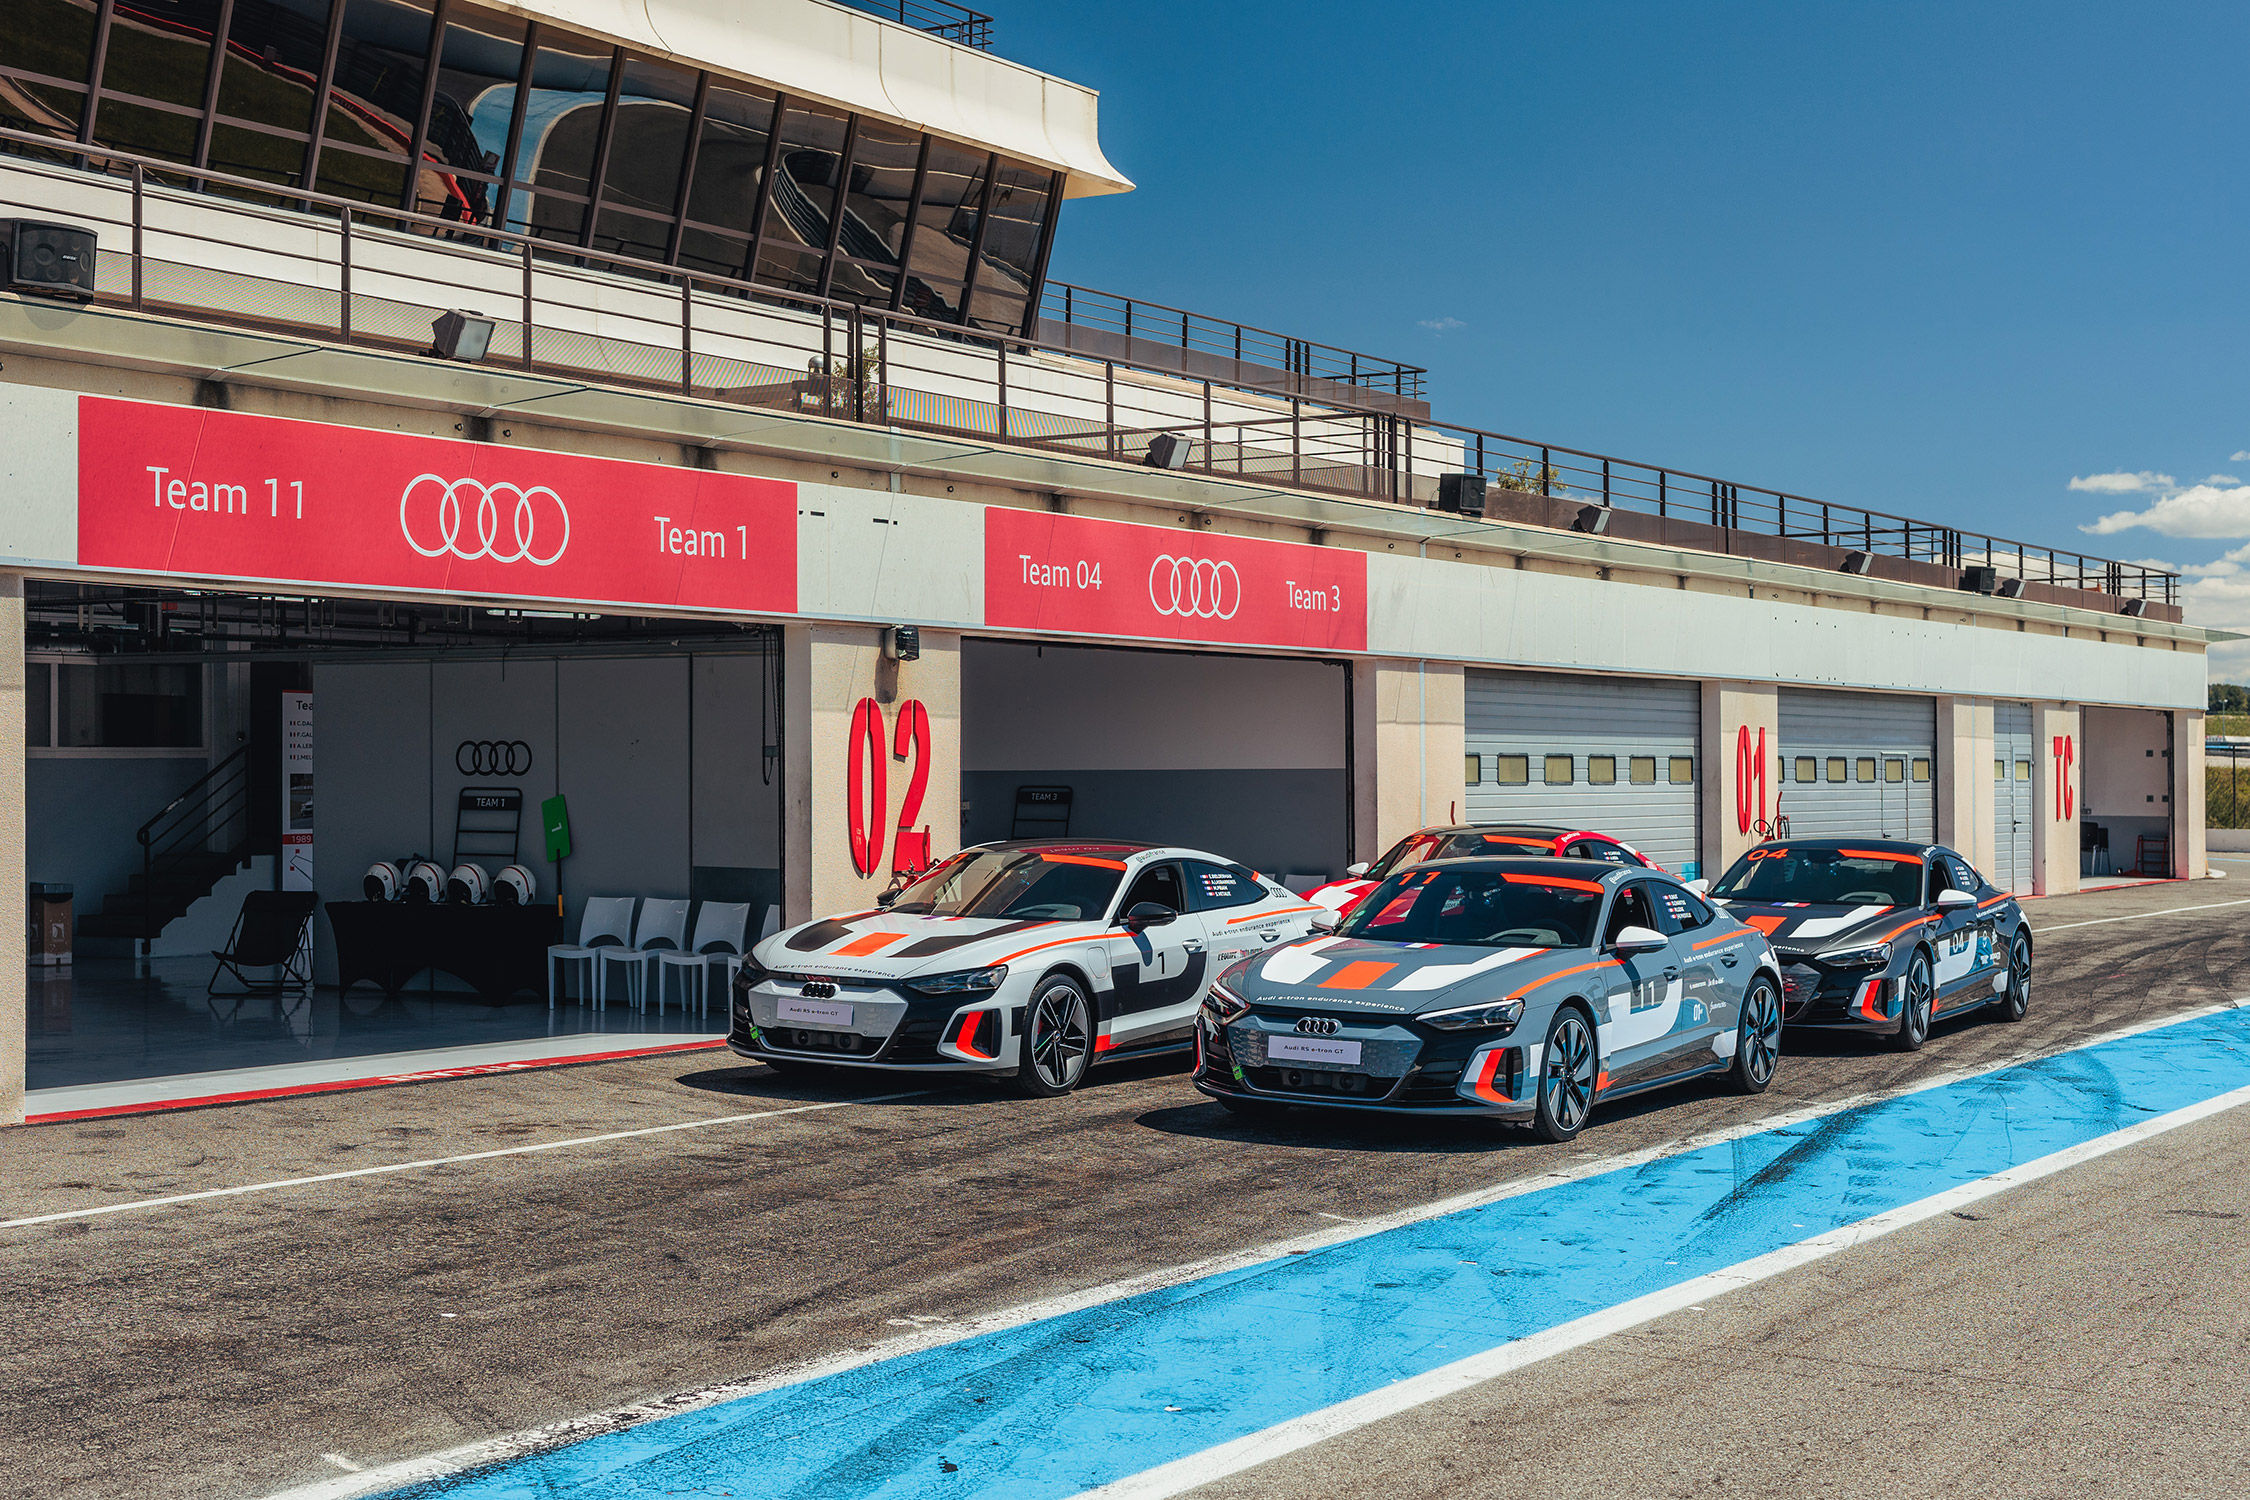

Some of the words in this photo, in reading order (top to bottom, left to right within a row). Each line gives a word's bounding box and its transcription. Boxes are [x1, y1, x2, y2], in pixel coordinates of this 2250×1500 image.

[146, 465, 247, 515] Team
[264, 478, 303, 519] 11
[653, 516, 725, 558] Team
[736, 525, 747, 560] 1
[1018, 554, 1070, 588] Team
[1076, 560, 1102, 590] 04
[1285, 580, 1327, 612] Team
[1331, 585, 1341, 613] 3
[296, 700, 313, 711] Tea
[847, 697, 931, 874] 02
[1736, 725, 1766, 833] 01
[2053, 735, 2074, 822] TC
[476, 798, 498, 807] TEAM
[501, 798, 506, 808] 1
[1031, 793, 1051, 801] TEAM
[1052, 793, 1058, 801] 3
[291, 835, 312, 844] 1989
[1405, 834, 1426, 846] 3
[1747, 848, 1789, 861] 04
[1398, 871, 1441, 885] 11
[1952, 931, 1964, 953] 04
[815, 963, 852, 971] endurance
[854, 967, 897, 978] experience
[1157, 951, 1165, 974] 1
[1307, 996, 1353, 1004] endurance
[1355, 1000, 1406, 1012] experience
[1637, 981, 1655, 1009] 11
